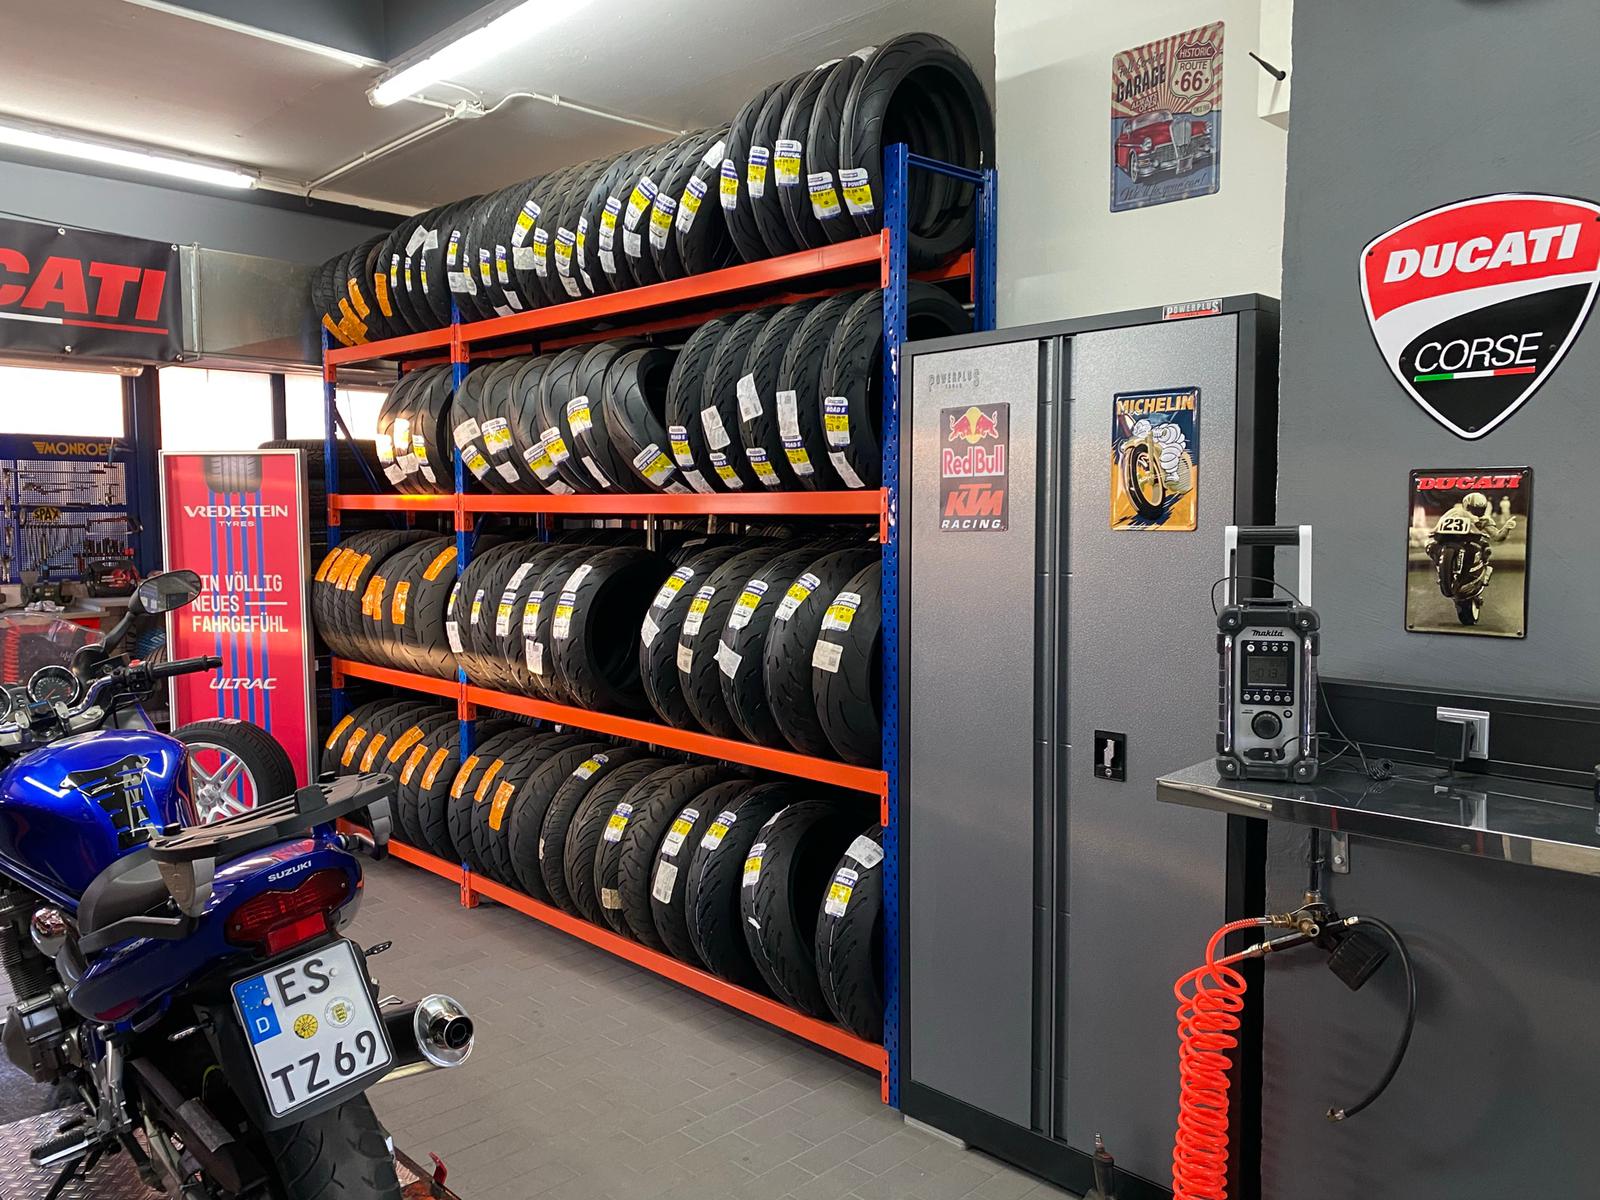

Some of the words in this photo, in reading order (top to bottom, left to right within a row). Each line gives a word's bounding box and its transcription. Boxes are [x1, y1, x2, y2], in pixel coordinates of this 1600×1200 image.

[1180, 46, 1212, 58] HISTORIC
[1180, 61, 1208, 71] ROUTE
[1116, 64, 1166, 103] GARAGE
[1181, 71, 1203, 92] 66
[1383, 223, 1582, 284] DUCATI
[1166, 301, 1219, 317] POWERPLUS
[1415, 332, 1543, 373] CORSE
[1116, 394, 1196, 415] MICHELIN
[44, 442, 111, 456] MONROE
[943, 448, 973, 476] Red
[974, 445, 1005, 475] Bull
[1417, 474, 1522, 491] DUCATI
[944, 483, 1004, 517] KTM
[34, 507, 59, 520] SPAX
[184, 505, 289, 518] VREDESTEIN
[941, 519, 1001, 530] RACING
[1442, 518, 1464, 532] 23
[200, 574, 220, 592] IN
[225, 571, 283, 592] VÖLLIG
[191, 595, 240, 612] NEUES
[192, 613, 289, 633] FAHRGEFÜHL
[209, 678, 277, 690] ULTRAC
[268, 860, 312, 882] SUZUKI
[274, 958, 330, 1008] ES
[256, 1016, 271, 1034] D
[271, 1051, 330, 1104] TZ
[334, 1030, 377, 1077] 69
